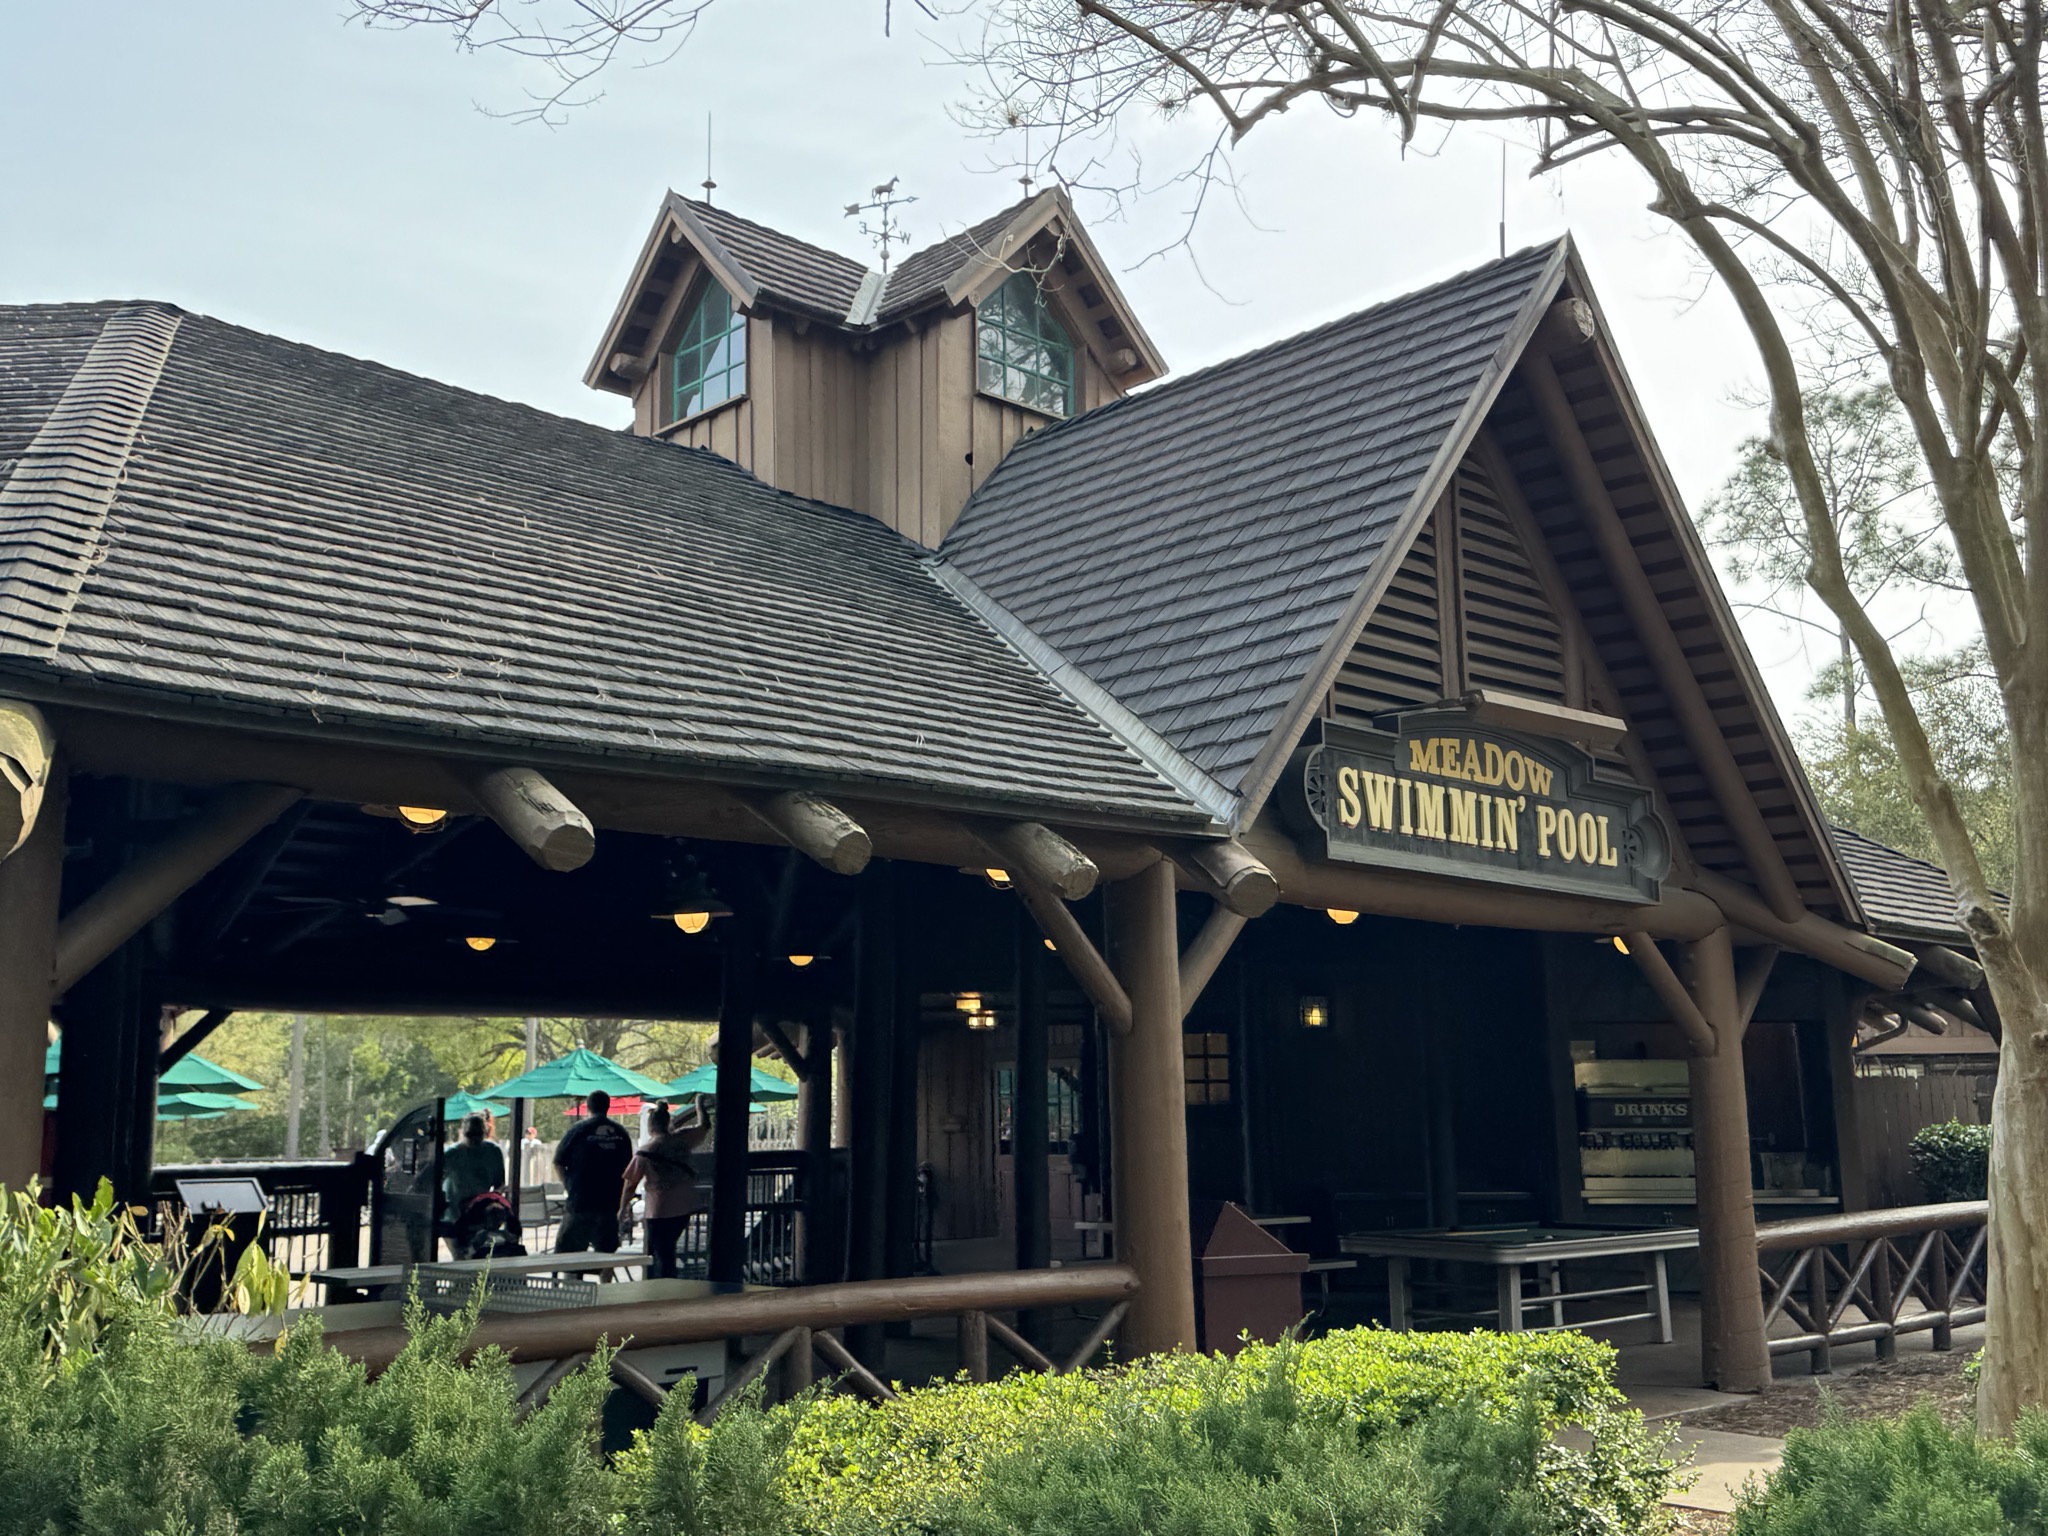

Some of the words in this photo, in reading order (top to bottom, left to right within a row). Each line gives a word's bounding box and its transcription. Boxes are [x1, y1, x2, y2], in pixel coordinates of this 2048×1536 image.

[1409, 738, 1553, 796] MEADOW
[1338, 767, 1526, 852] SWIMMIN'
[1537, 806, 1618, 867] POOL
[1614, 1103, 1688, 1116] DRINKS
